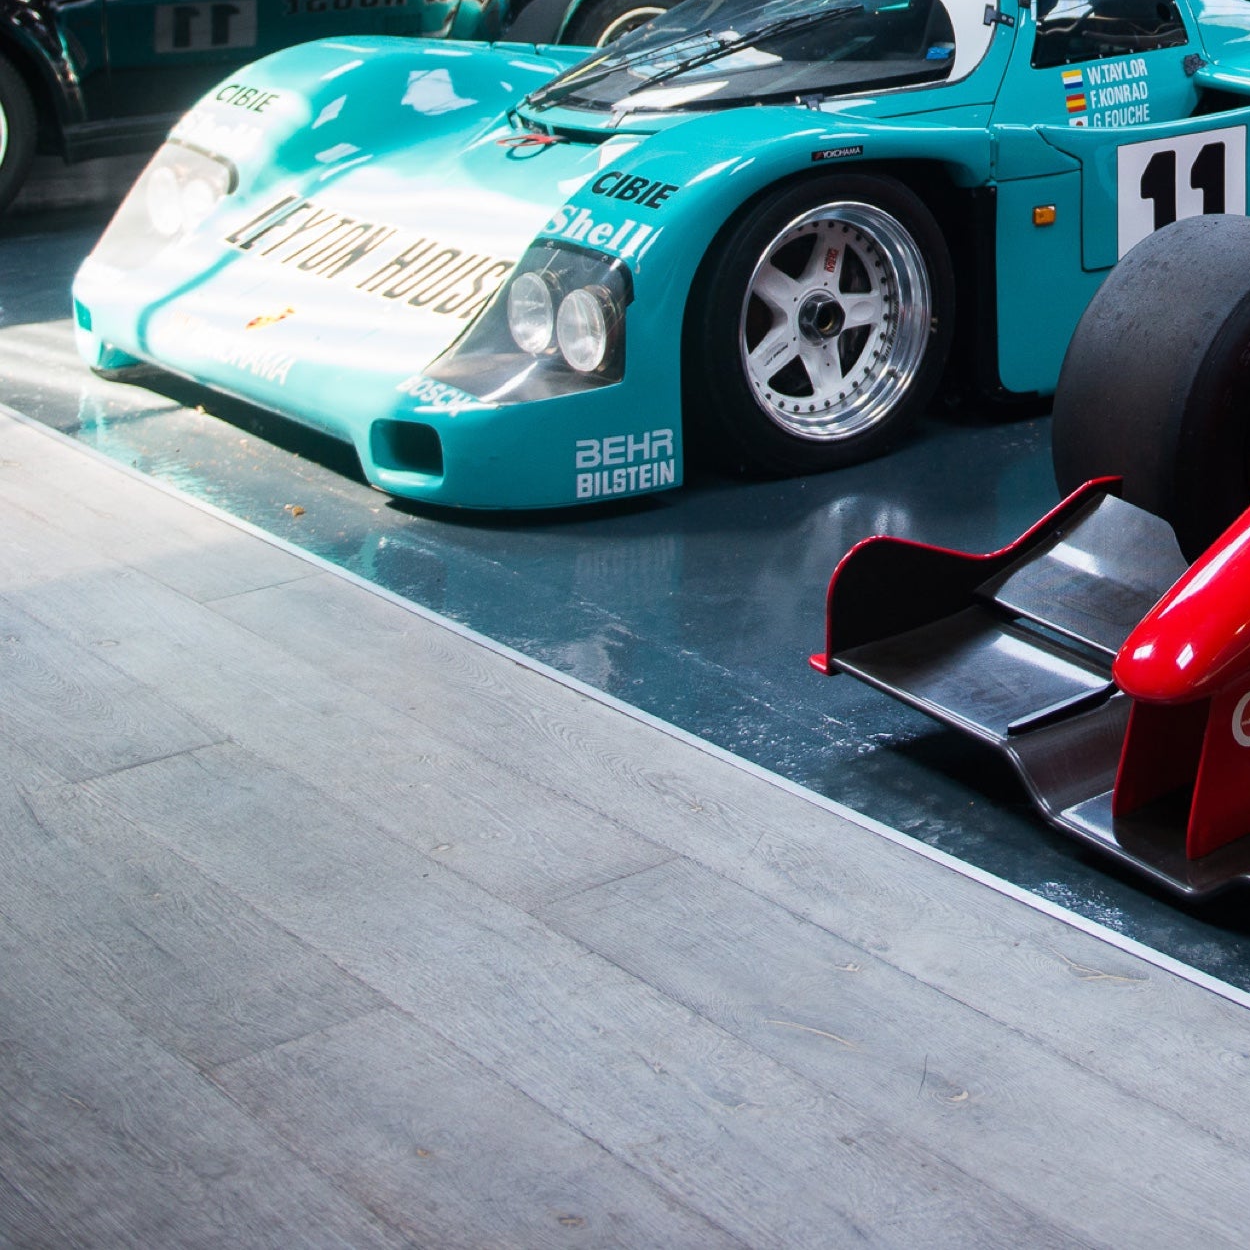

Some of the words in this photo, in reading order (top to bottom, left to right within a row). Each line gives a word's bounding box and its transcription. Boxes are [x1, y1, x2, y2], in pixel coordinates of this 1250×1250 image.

[1087, 58, 1148, 86] W.TAYLOR
[214, 83, 281, 113] CIBIE
[1090, 81, 1148, 109] F.KONRAD
[823, 146, 861, 159] YOKOHAMA
[591, 170, 680, 209] CIBIE
[1140, 141, 1226, 232] 11
[224, 195, 397, 279] LEYTON
[541, 204, 654, 258] Shell
[576, 428, 673, 469] BEHR
[576, 459, 675, 499] BILSTEIN
